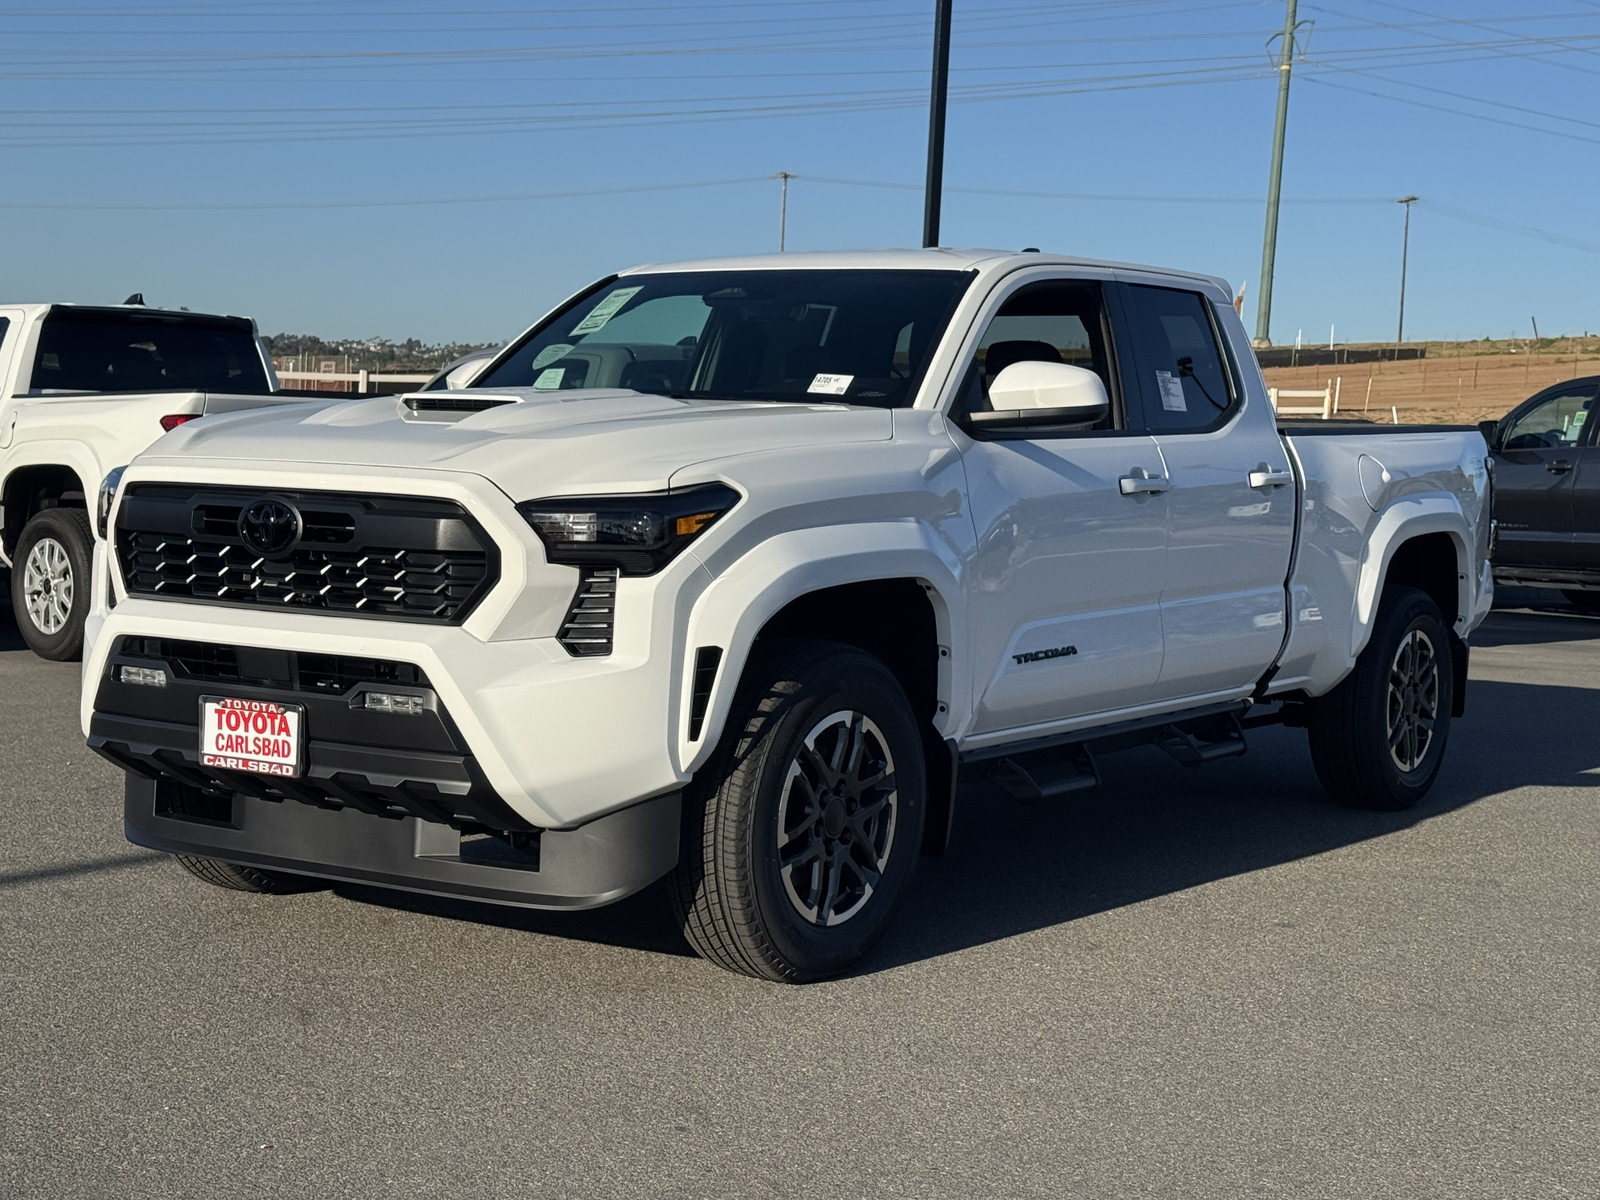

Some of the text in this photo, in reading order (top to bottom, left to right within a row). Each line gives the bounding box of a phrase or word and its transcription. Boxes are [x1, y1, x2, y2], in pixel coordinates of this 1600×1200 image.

[1012, 645, 1078, 664] TACOMA
[224, 699, 277, 713] TOYOTA
[214, 708, 292, 737] TOYOTA
[215, 732, 291, 758] CARLSBAD
[203, 755, 294, 776] CARLSBAD
